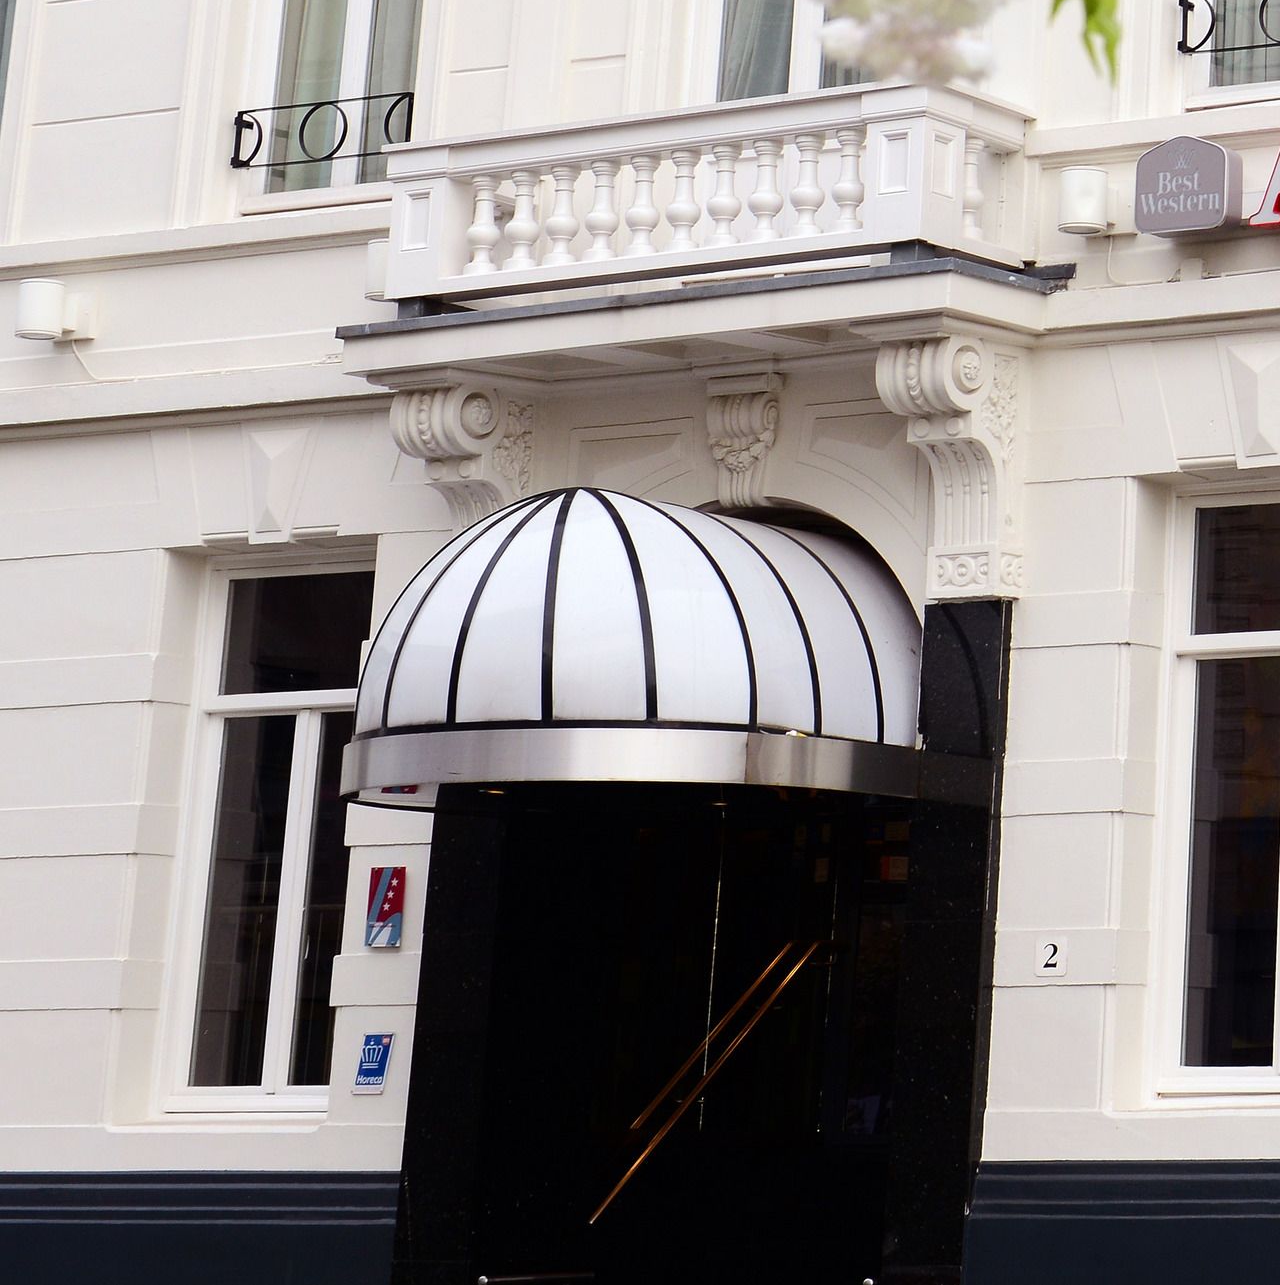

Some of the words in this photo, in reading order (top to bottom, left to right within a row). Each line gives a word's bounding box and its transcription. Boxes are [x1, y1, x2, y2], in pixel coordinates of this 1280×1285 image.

[1157, 171, 1199, 195] Best
[1140, 190, 1220, 215] Western
[1043, 943, 1058, 969] 2
[356, 1074, 383, 1085] Horeca
